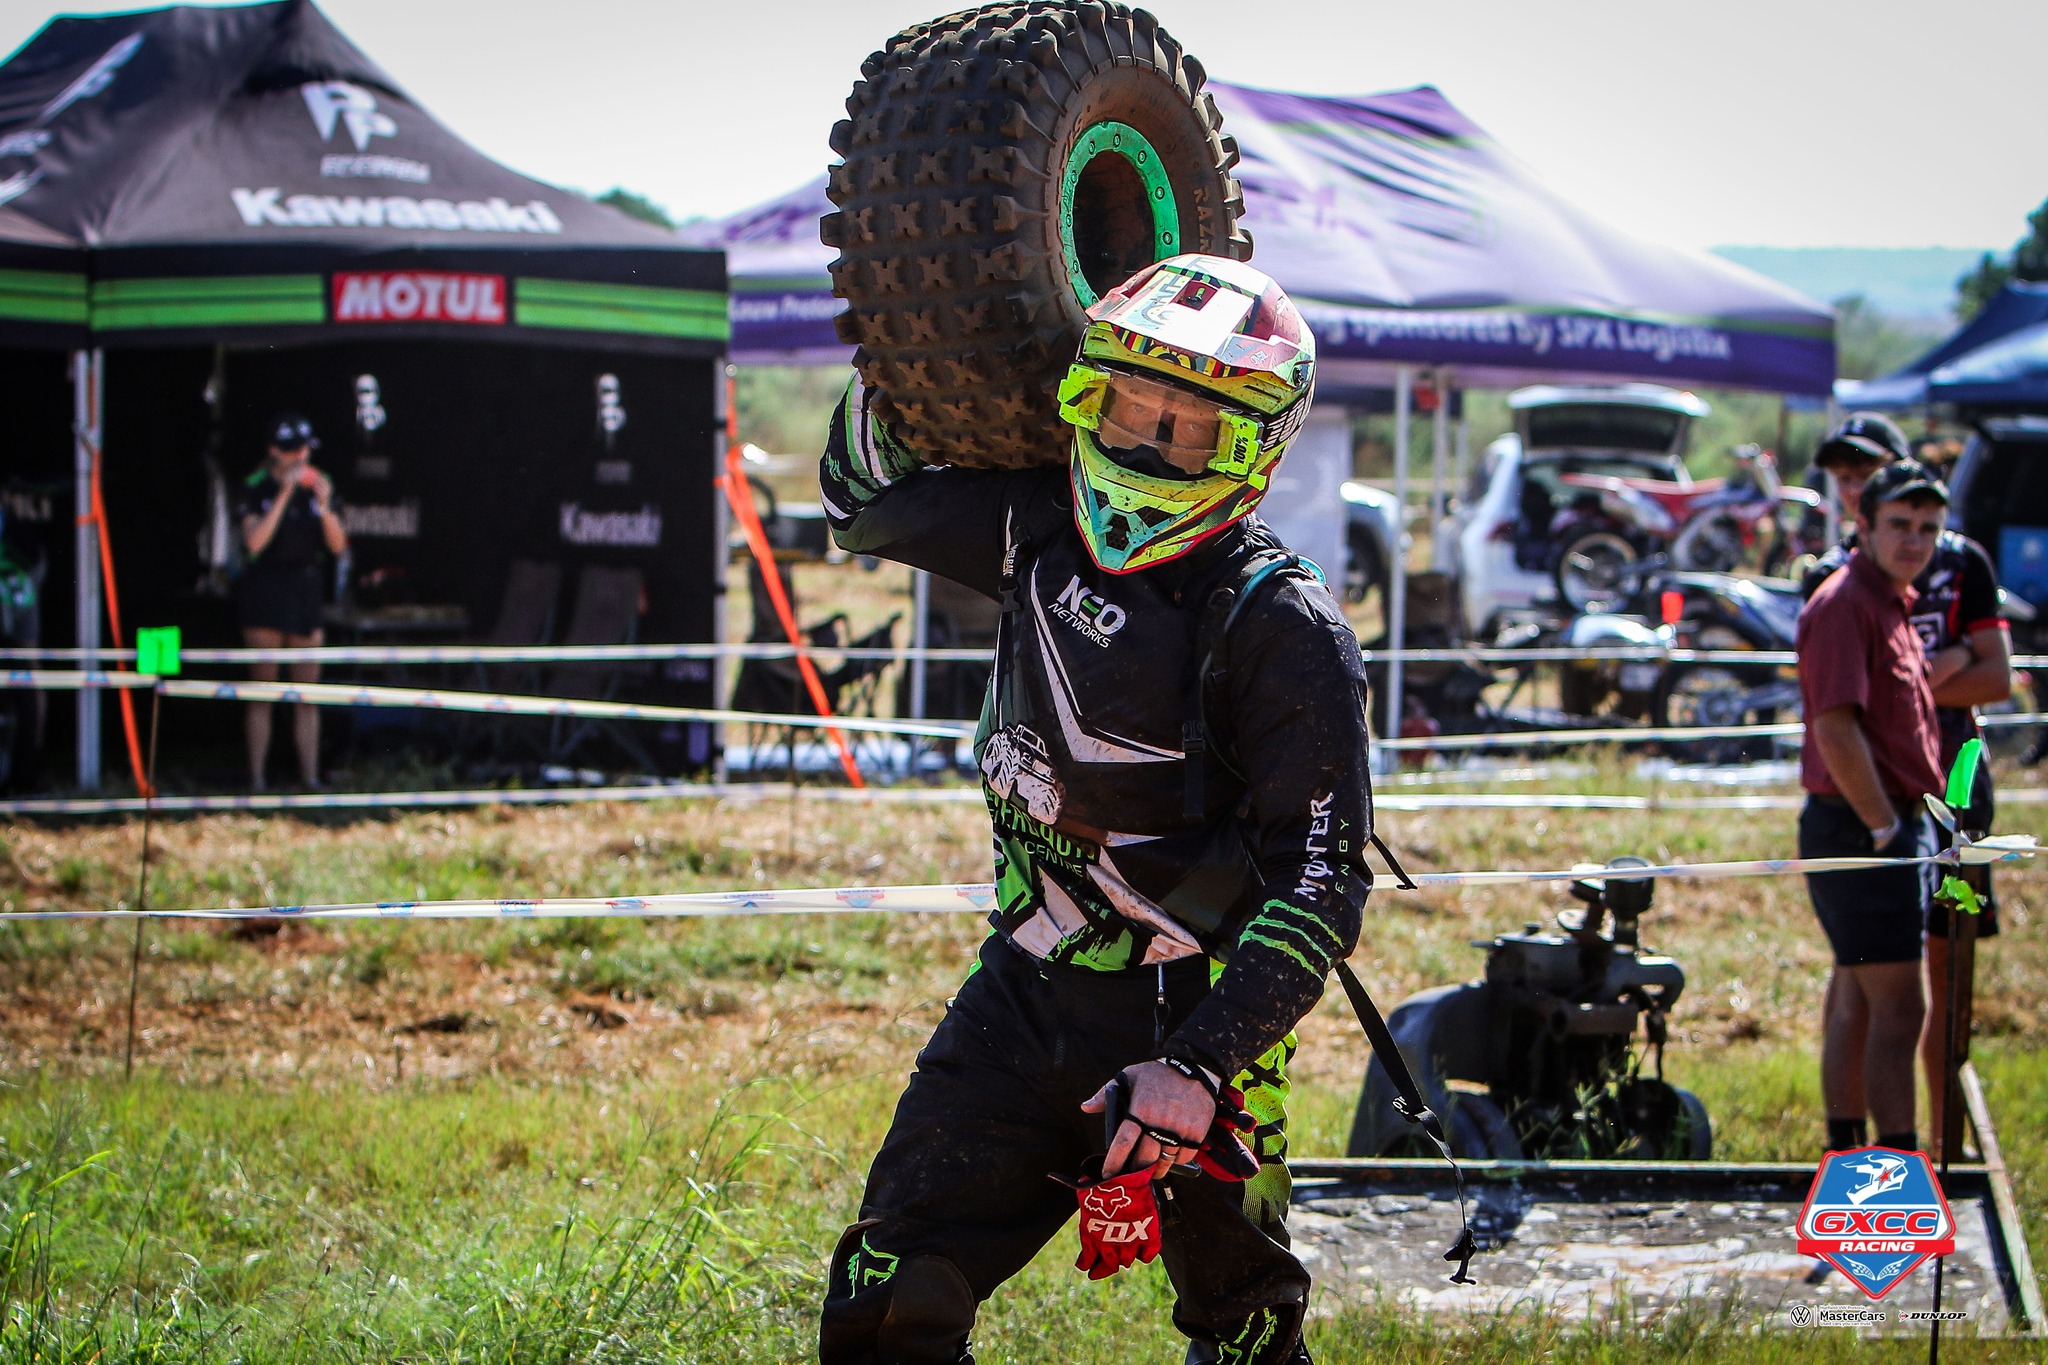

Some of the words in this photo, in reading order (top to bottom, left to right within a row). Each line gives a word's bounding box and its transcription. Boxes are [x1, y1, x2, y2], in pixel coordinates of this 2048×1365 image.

[231, 187, 562, 234] Kawasaki
[338, 275, 502, 320] MOTUL
[1511, 311, 1549, 354] by
[1233, 434, 1249, 465] 100%
[1048, 602, 1112, 649] NETWORKS
[1056, 574, 1126, 636] NEO
[1087, 1215, 1154, 1243] FOX
